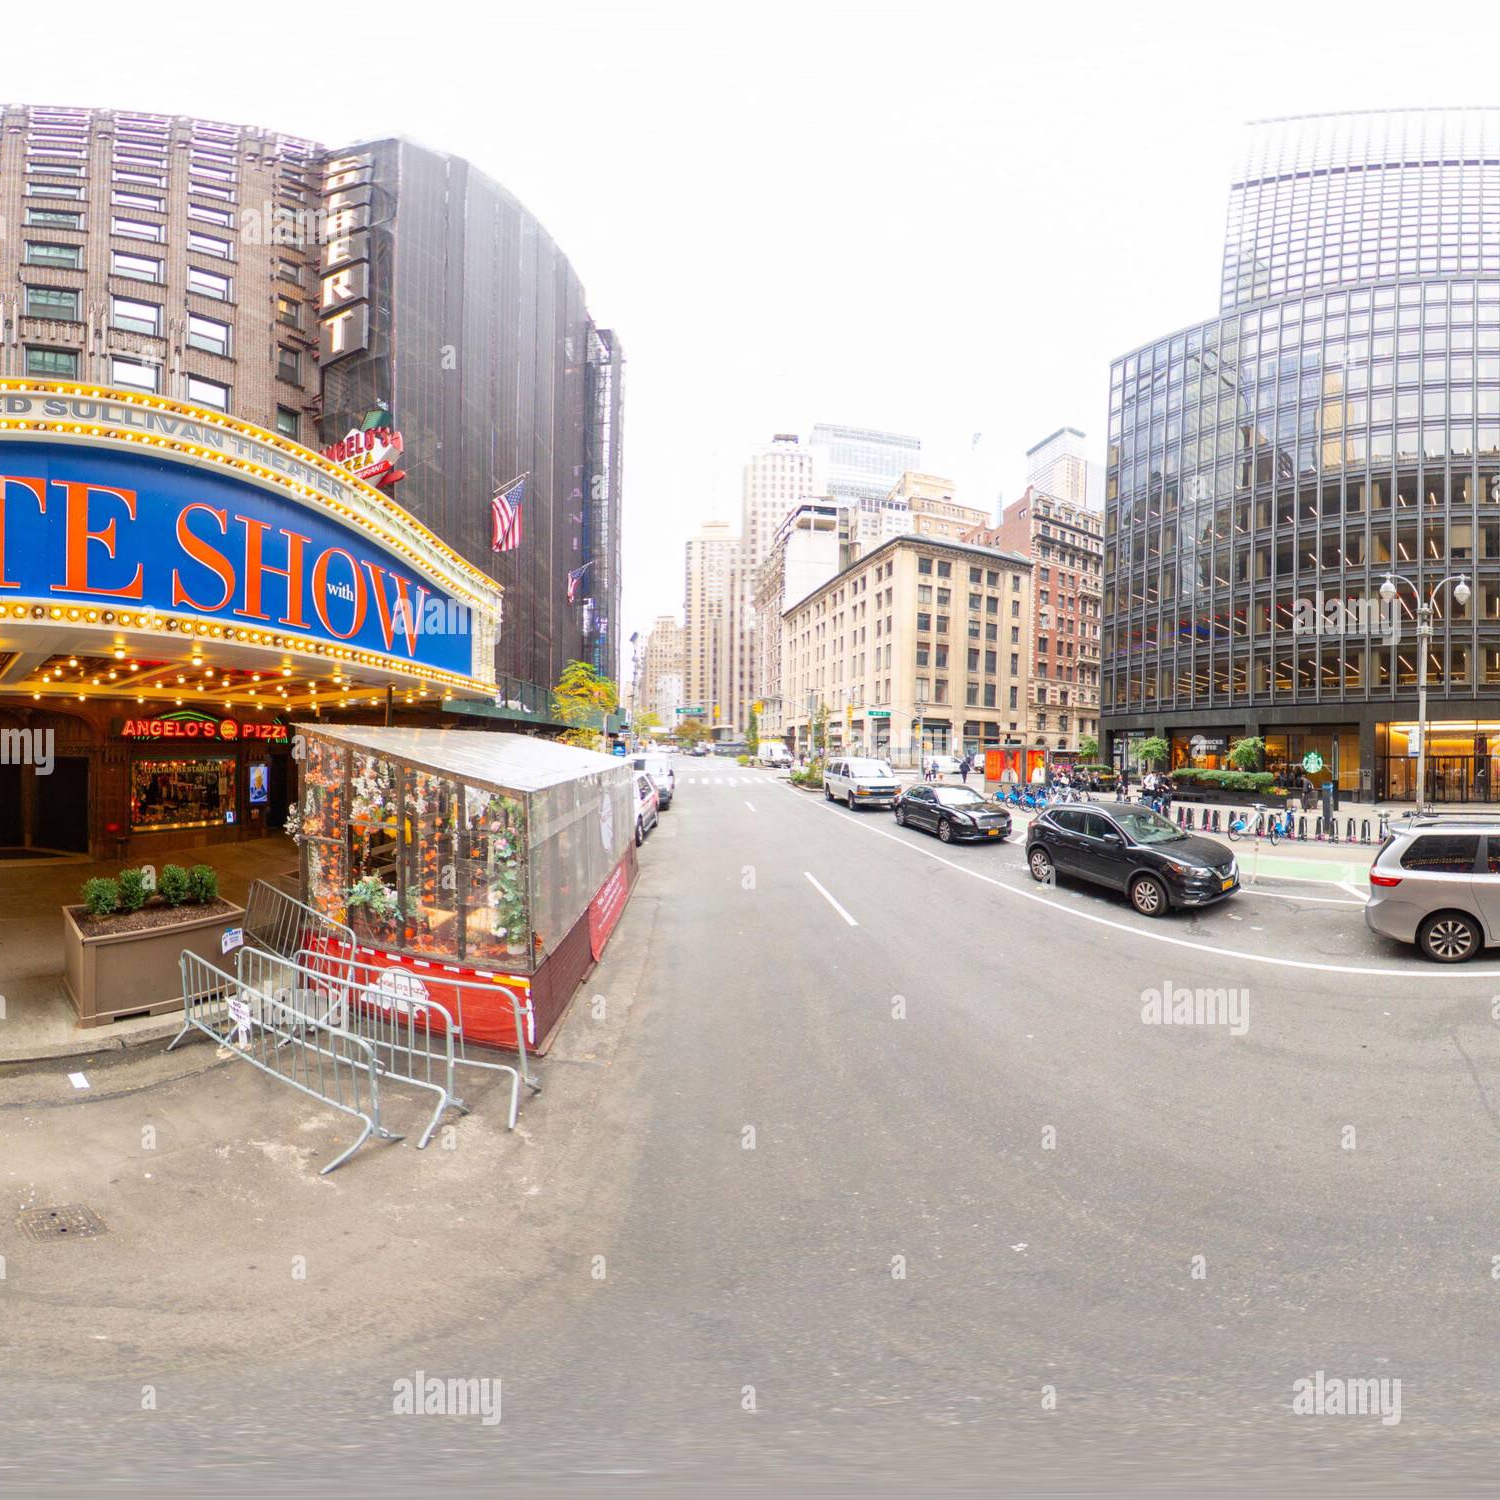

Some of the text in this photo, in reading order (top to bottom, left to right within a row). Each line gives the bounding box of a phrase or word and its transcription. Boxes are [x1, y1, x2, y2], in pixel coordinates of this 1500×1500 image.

[43, 398, 224, 449] SULLIVAN
[231, 434, 345, 501] THEATER
[172, 502, 431, 657] SHOW
[327, 581, 355, 602] with
[121, 720, 216, 737] ANGELO'S
[242, 724, 287, 738] PIZZA
